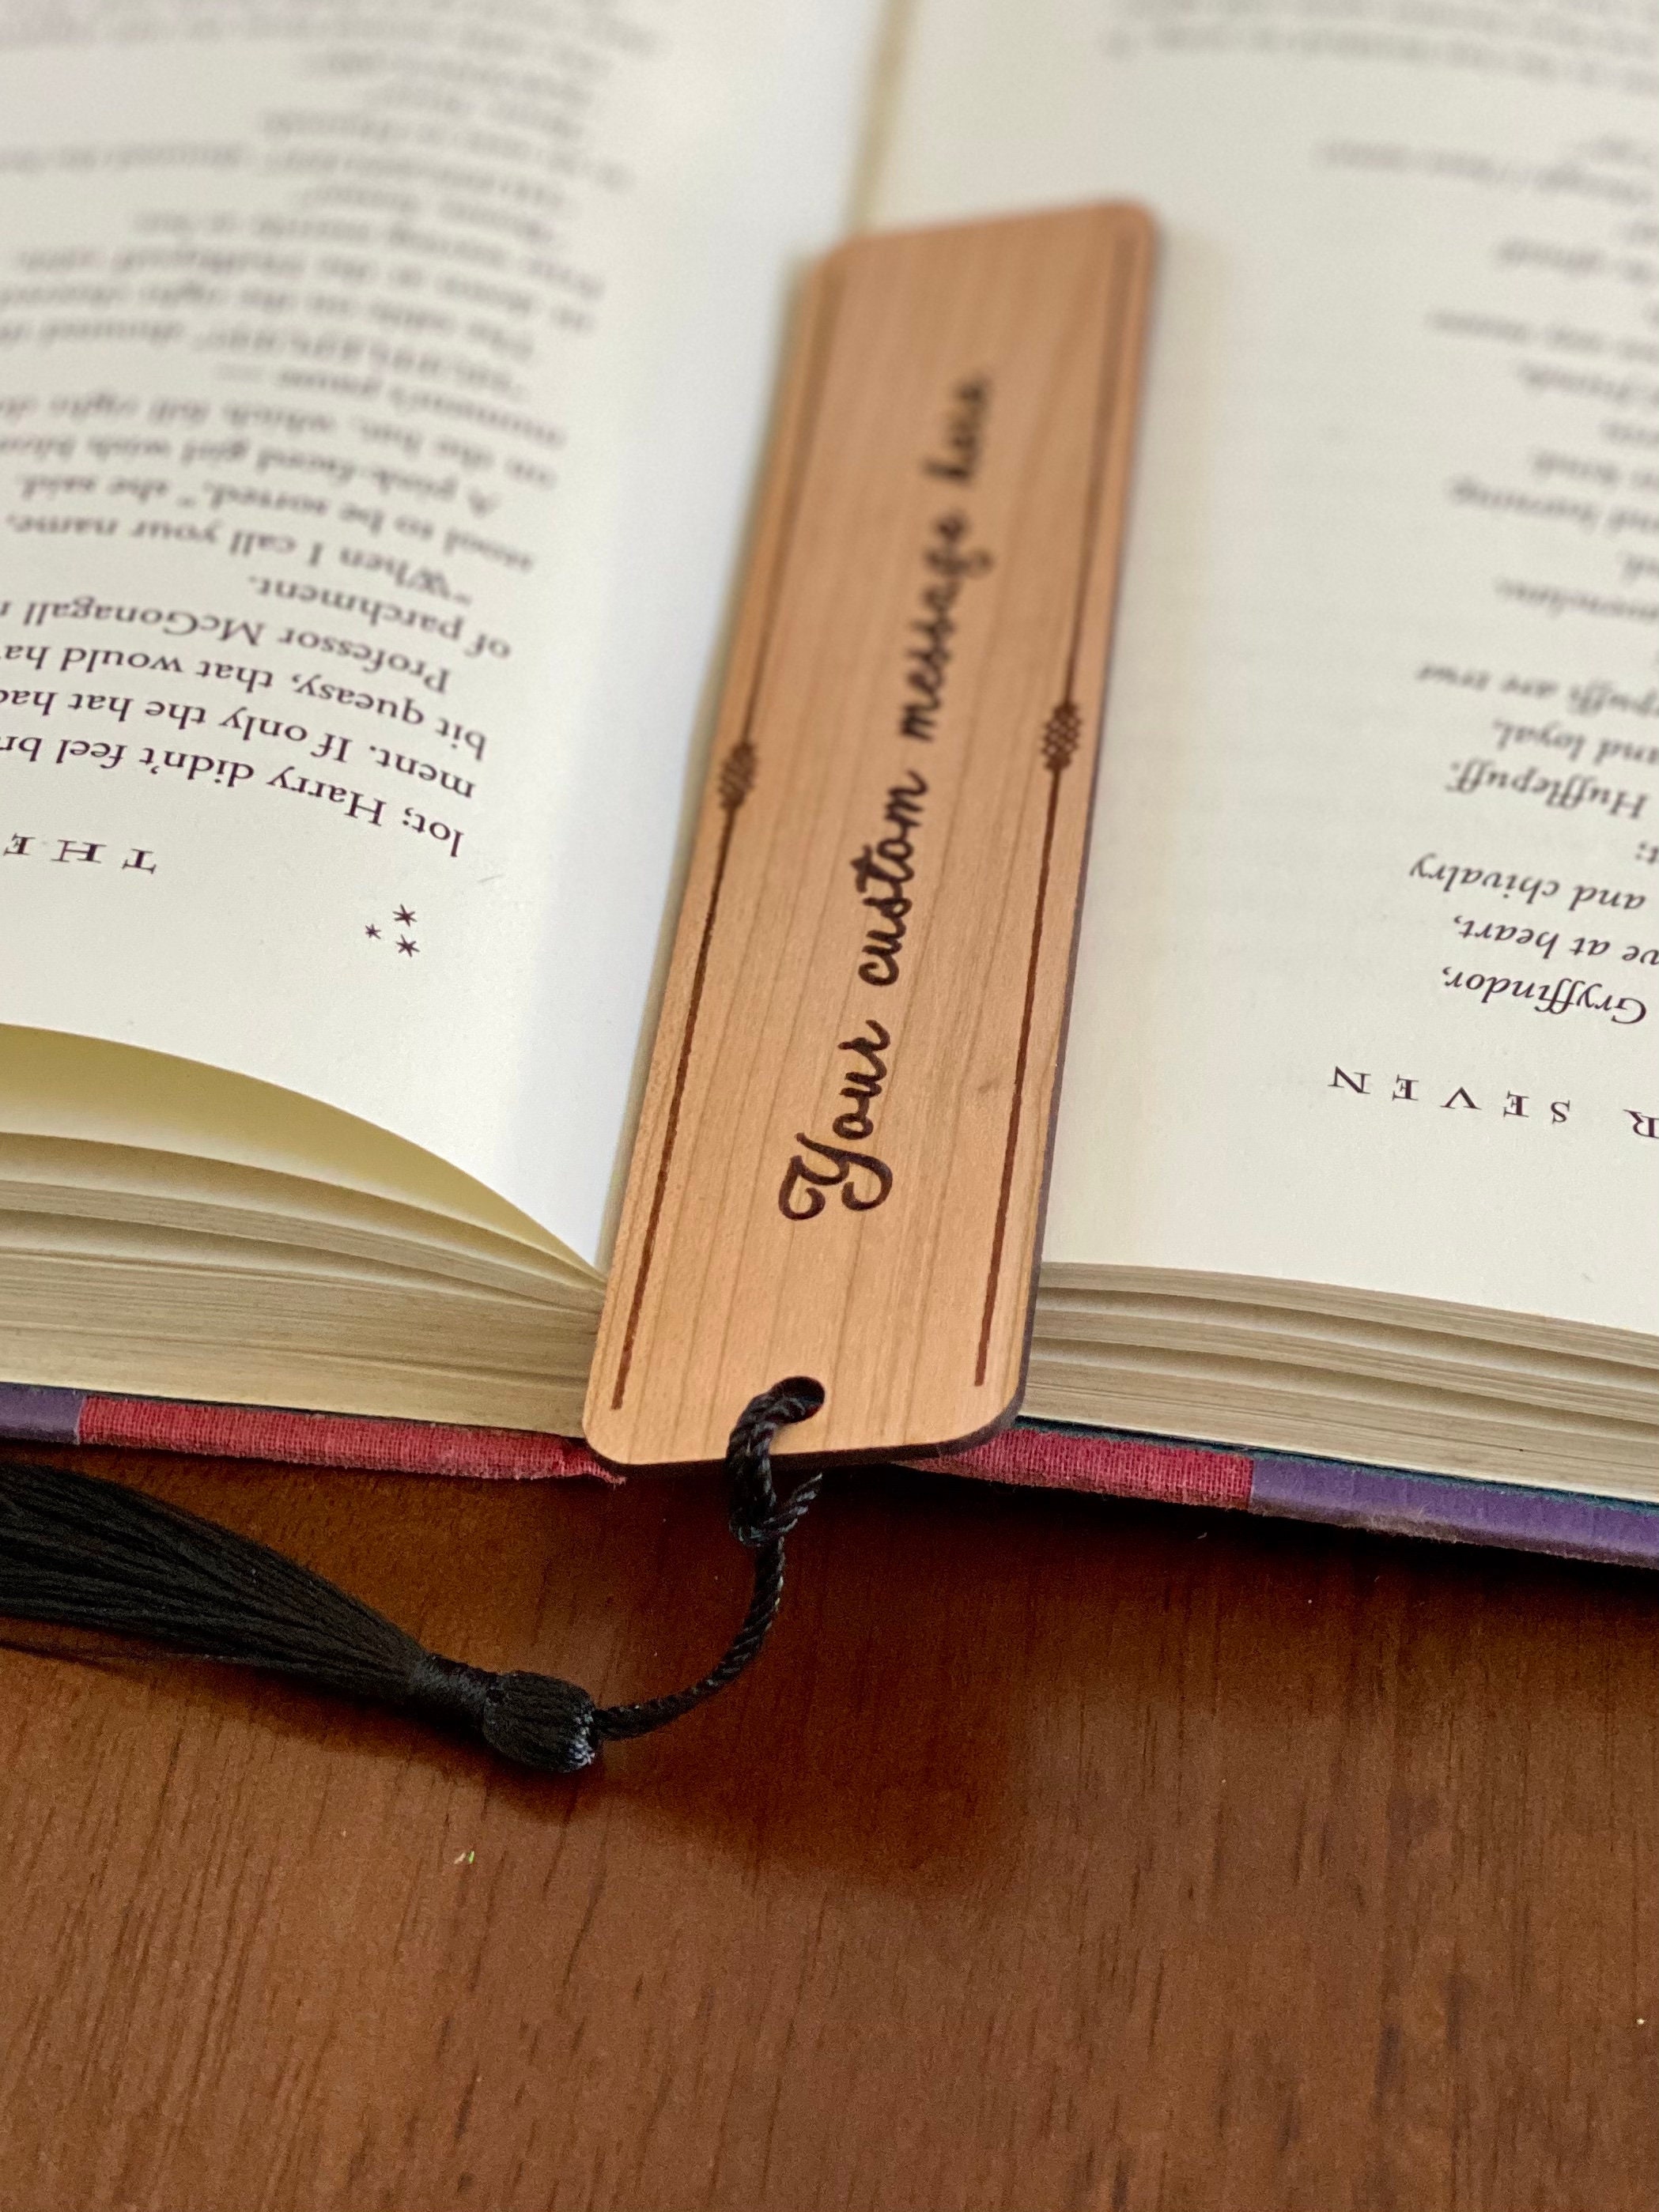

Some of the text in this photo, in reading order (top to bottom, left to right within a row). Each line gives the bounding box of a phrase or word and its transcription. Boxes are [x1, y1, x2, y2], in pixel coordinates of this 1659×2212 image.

[130, 519, 223, 545] your
[229, 530, 297, 556] call
[307, 542, 323, 568] I
[248, 576, 512, 660] of parchment.
[23, 595, 451, 696] Professor McGonagall
[0, 645, 487, 762] bit queasy, that would ha
[68, 693, 134, 723] hat
[145, 700, 206, 730] the
[218, 707, 308, 742] only
[56, 738, 127, 769] feel
[311, 733, 353, 764] If
[369, 746, 476, 799] ment.
[266, 766, 387, 827] Harry
[2, 832, 157, 874] THE
[402, 807, 464, 858] lot;
[778, 1021, 892, 1221] Your
[850, 771, 928, 986] custom
[896, 508, 994, 743] message
[1408, 853, 1646, 911] and chivalry
[1453, 915, 1559, 959] heart,
[1570, 937, 1611, 958] at
[1441, 966, 1647, 1025] Gryffindor,
[1327, 1066, 1570, 1124] SEVEN
